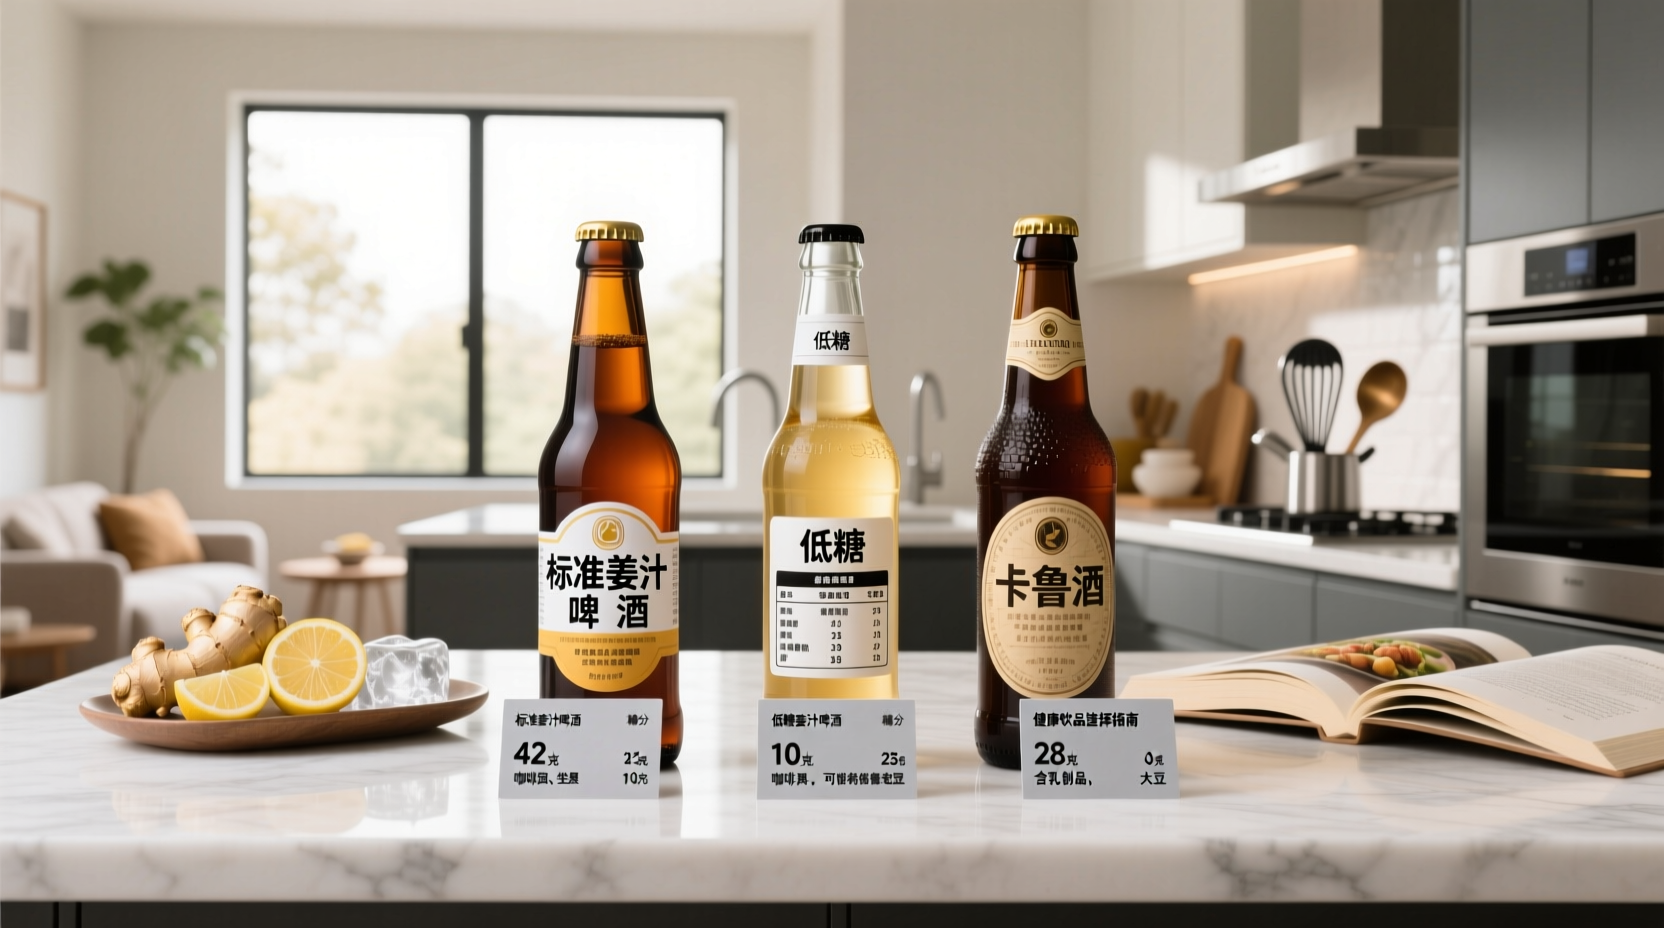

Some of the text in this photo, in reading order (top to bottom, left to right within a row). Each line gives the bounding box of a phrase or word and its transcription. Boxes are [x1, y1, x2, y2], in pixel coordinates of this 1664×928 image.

[814, 330, 851, 351] 低糖
[800, 528, 866, 564] 低糖
[546, 553, 668, 591] 标准姜汁
[996, 563, 1104, 608] 卡鲁酒
[569, 594, 649, 629] 啤酒
[1140, 772, 1167, 785] 大豆
